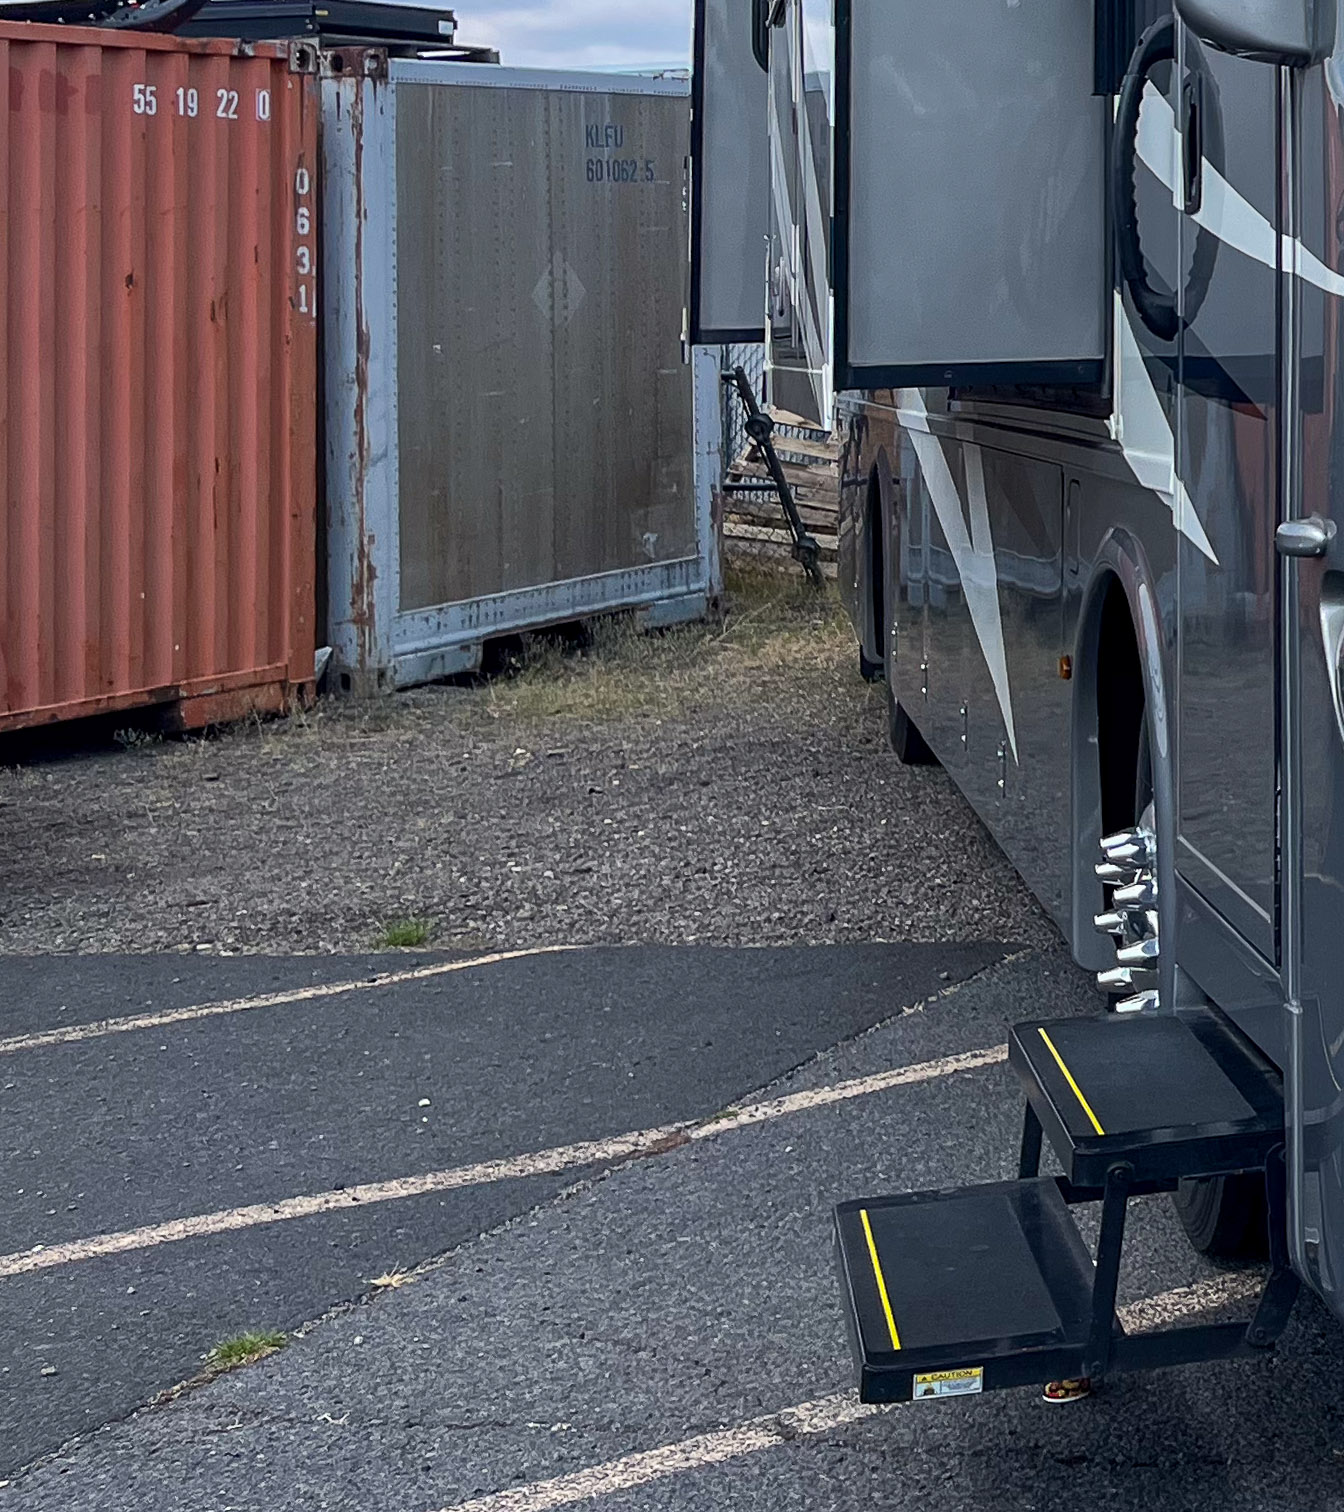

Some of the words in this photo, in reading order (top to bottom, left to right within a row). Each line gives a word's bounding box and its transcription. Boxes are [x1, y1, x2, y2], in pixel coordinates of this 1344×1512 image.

[132, 84, 157, 115] 55
[176, 87, 199, 117] 19
[216, 89, 239, 119] 22
[257, 89, 270, 120] 0
[585, 124, 624, 148] KLFU
[586, 158, 639, 183] 601062
[930, 1370, 973, 1381] CAUTION
